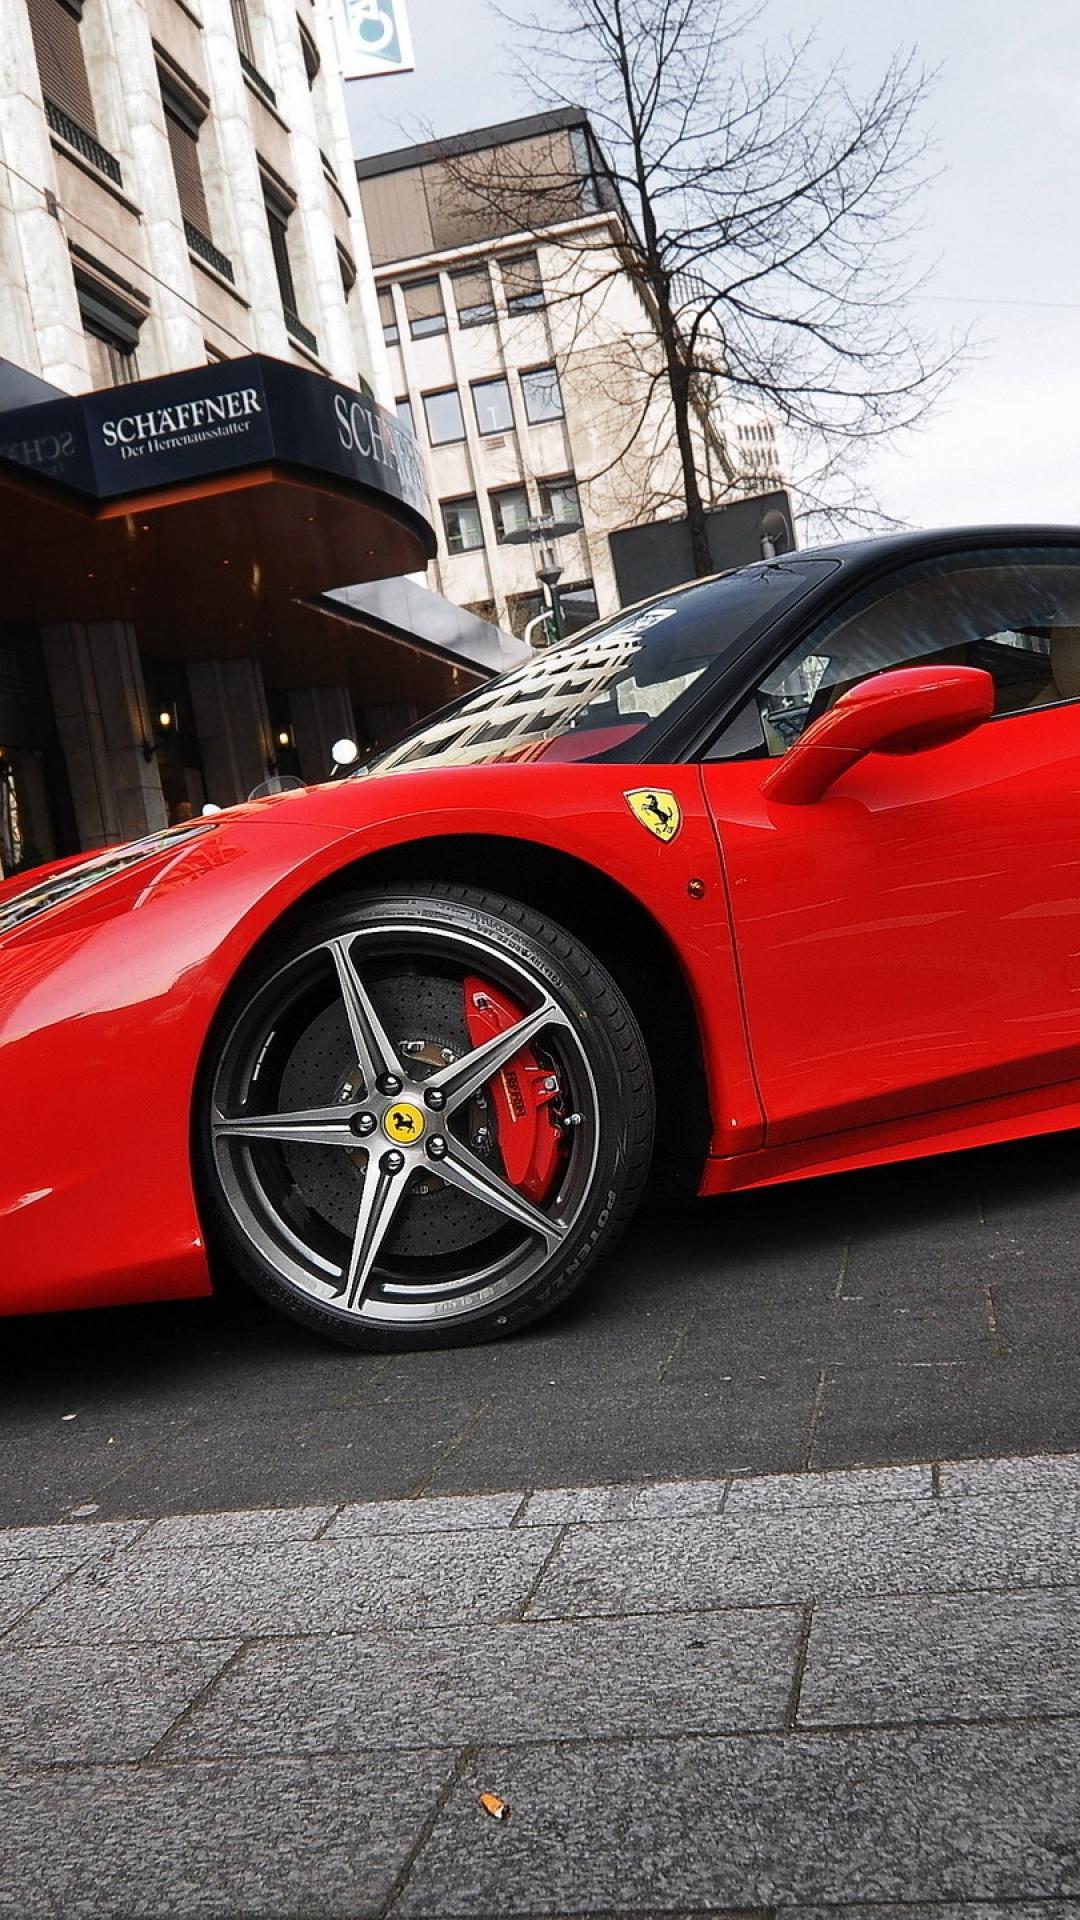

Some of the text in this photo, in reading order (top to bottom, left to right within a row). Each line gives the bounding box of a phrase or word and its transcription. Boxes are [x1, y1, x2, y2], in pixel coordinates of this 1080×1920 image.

[102, 388, 262, 446] SCHÄFFNER
[120, 420, 251, 460] Der Herrenausstatter
[535, 1190, 617, 1300] POTENZA
